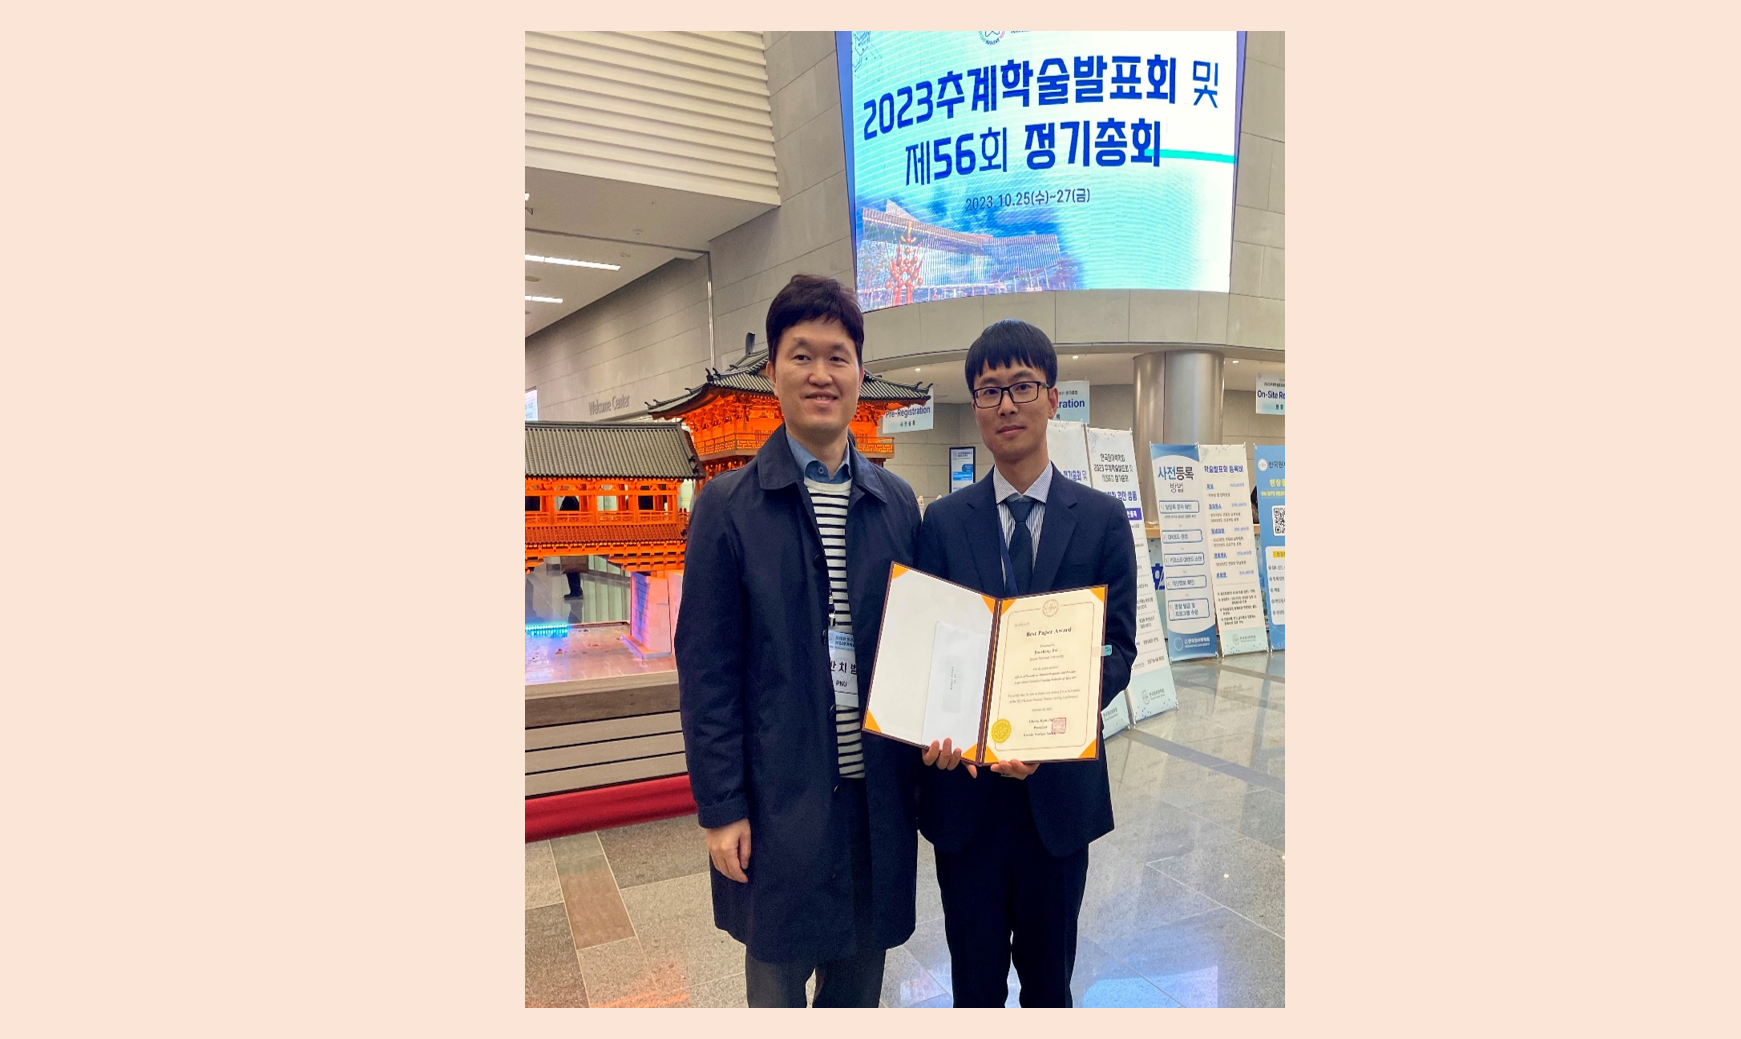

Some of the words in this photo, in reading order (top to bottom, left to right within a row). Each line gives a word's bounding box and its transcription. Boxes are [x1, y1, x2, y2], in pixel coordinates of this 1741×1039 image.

[863, 54, 1177, 141] 2023추계학술발표회
[1192, 60, 1219, 109] 및
[905, 126, 1008, 186] 제56회
[1024, 117, 1161, 170] 정기총회
[1257, 390, 1278, 399] On-Site
[588, 399, 611, 416] Welcome
[612, 395, 630, 411] Center
[1057, 398, 1085, 409] ration
[885, 406, 931, 419] Pre-Registration
[1157, 466, 1195, 480] 사전등록
[1170, 482, 1184, 494] 방법
